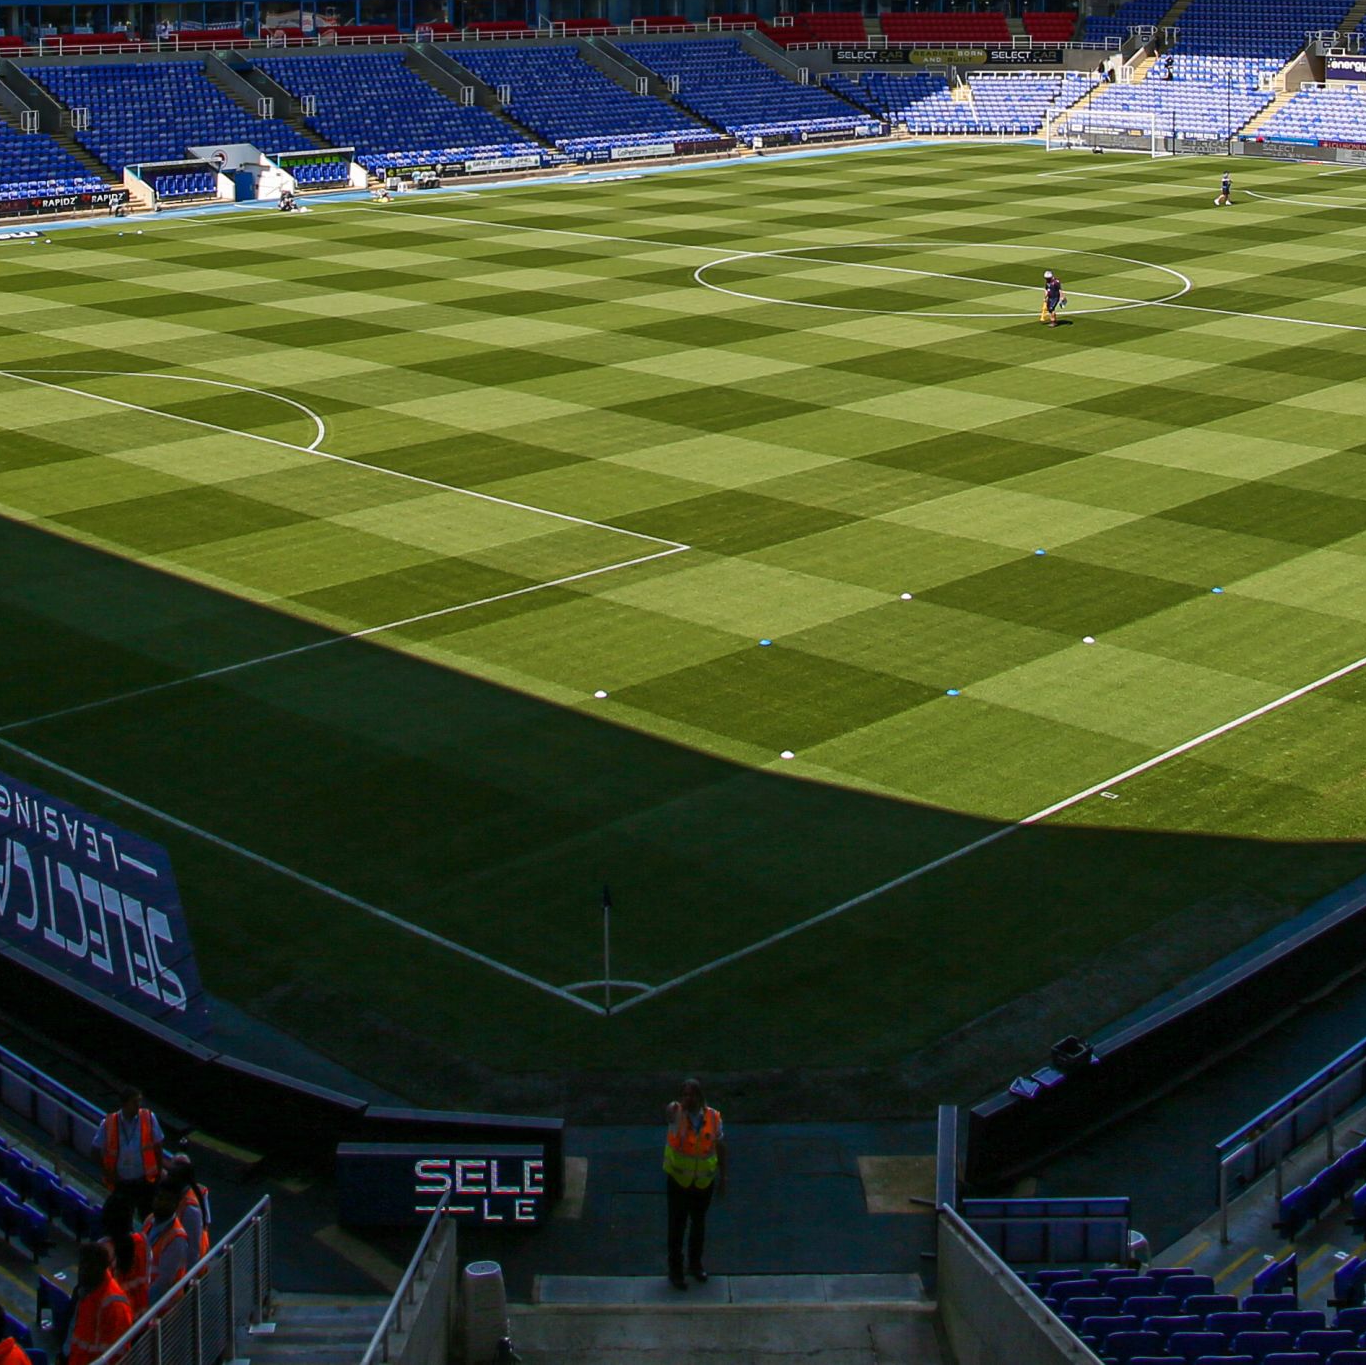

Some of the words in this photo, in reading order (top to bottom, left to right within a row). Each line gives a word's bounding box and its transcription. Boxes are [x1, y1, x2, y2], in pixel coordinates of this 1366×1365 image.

[837, 51, 877, 59] SELECT
[42, 196, 78, 208] RAPIDZ
[91, 191, 126, 203] RAPIDZ
[414, 1159, 544, 1195] SELE
